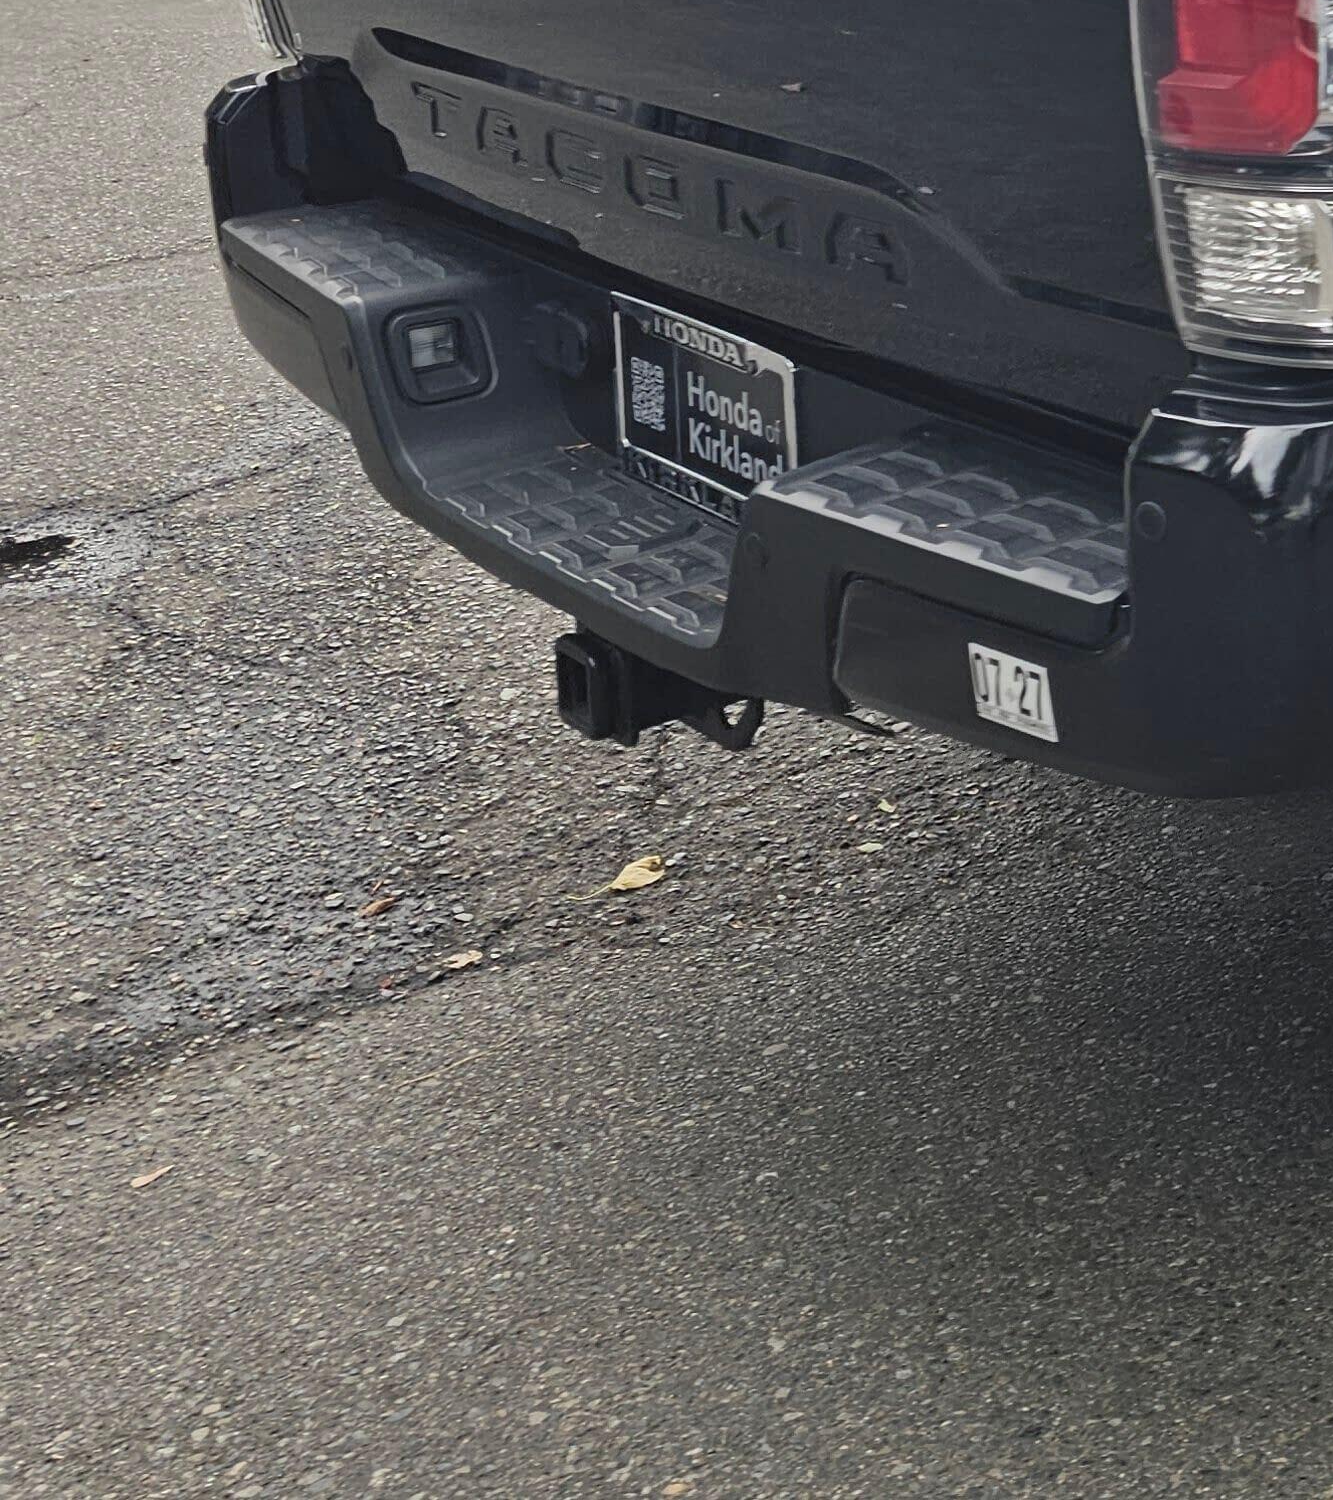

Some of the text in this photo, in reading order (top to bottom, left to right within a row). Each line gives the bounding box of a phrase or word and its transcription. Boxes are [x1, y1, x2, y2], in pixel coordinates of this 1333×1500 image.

[410, 81, 908, 285] TACOMA
[653, 315, 745, 367] HONDA
[686, 370, 782, 445] Honda of
[688, 417, 784, 483] Kirkland
[971, 652, 1001, 707] 07
[1014, 665, 1043, 720] 27
